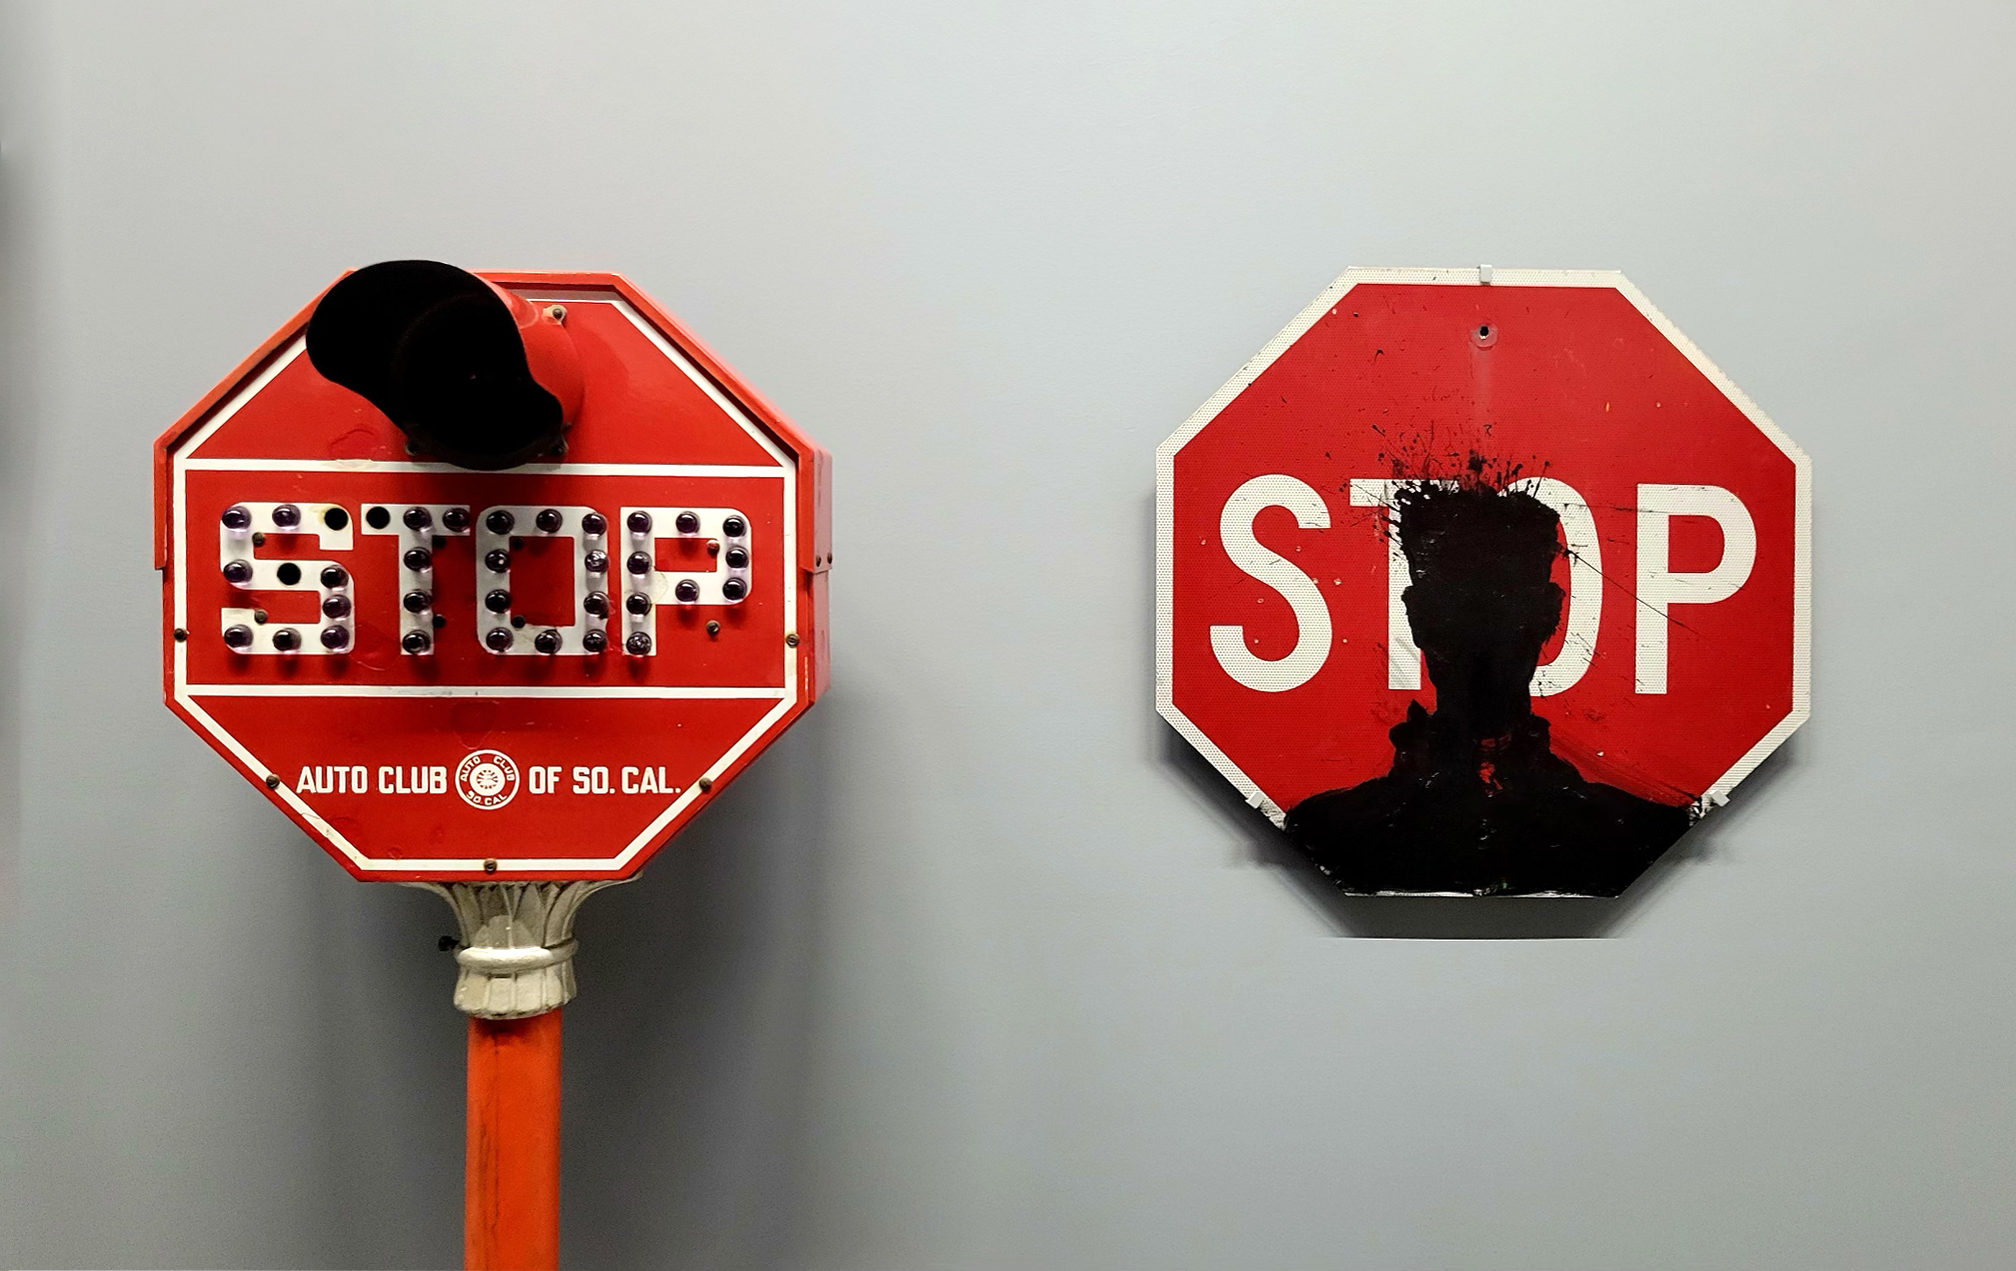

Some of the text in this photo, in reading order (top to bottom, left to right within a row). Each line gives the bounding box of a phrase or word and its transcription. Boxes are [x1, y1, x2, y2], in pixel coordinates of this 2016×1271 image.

[219, 501, 753, 656] STOP
[296, 765, 682, 794] AUTO CLUB OF SO. CAL.
[460, 756, 516, 782] AUTO CLUB
[484, 794, 508, 806] CAL
